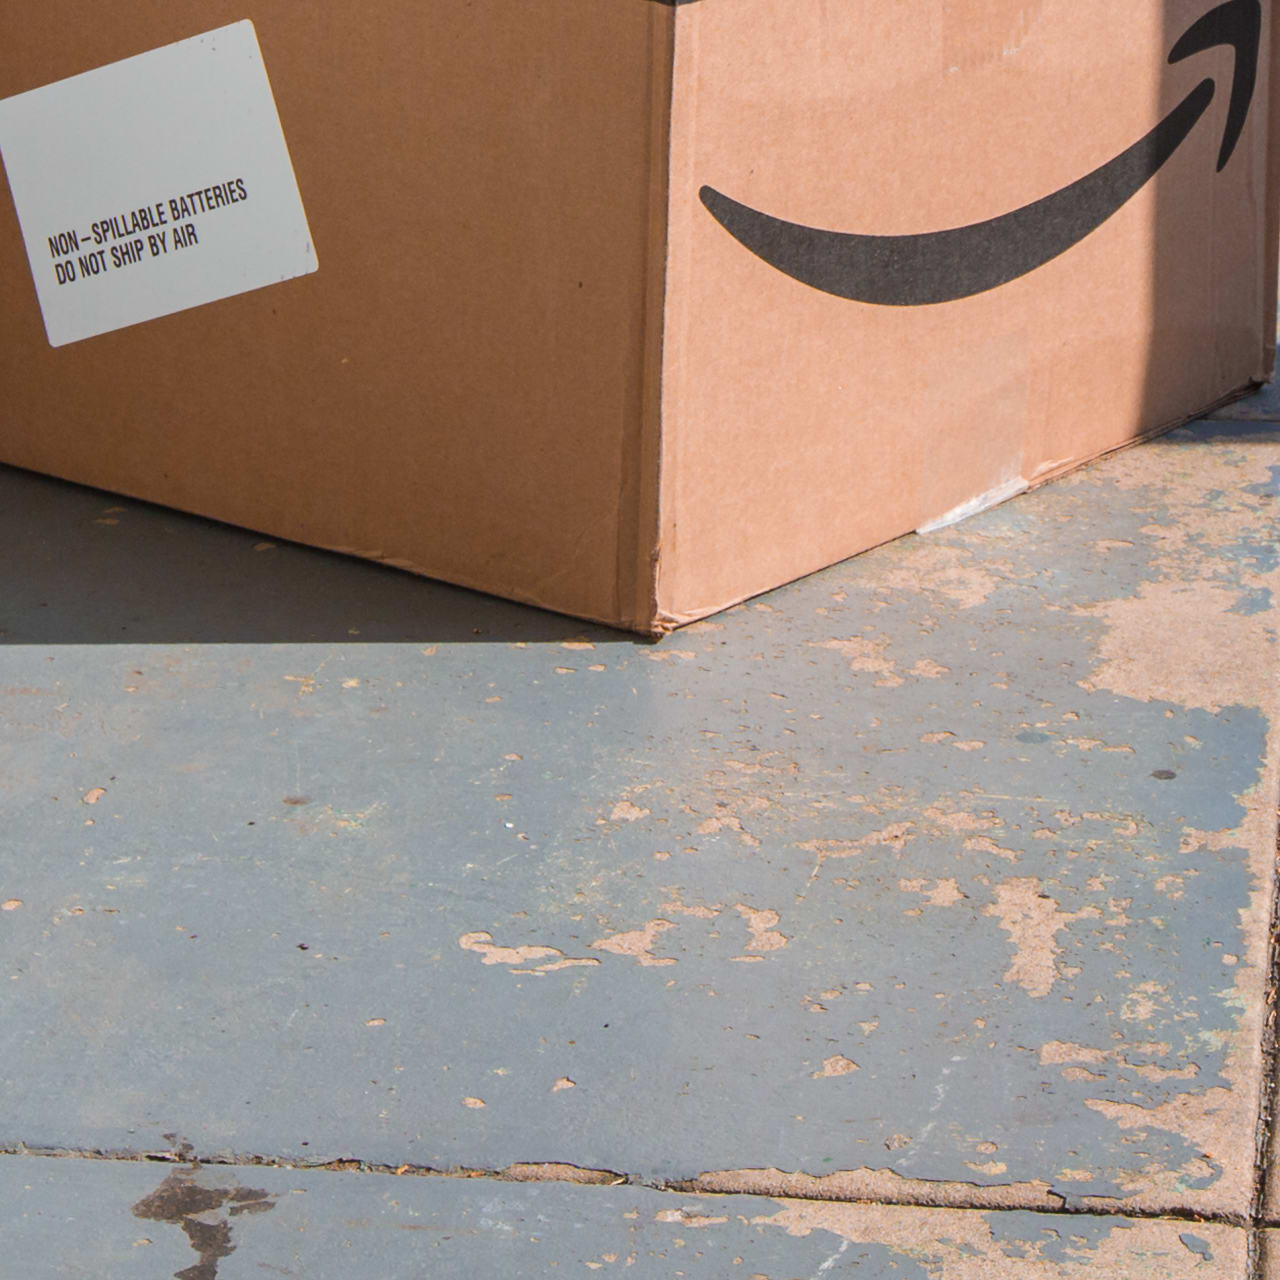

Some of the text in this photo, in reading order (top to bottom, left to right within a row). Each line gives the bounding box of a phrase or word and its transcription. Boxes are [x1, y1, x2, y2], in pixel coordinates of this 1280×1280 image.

[168, 177, 248, 222] BATTERIES
[54, 222, 200, 285] DO NOT SHIP BY AIR
